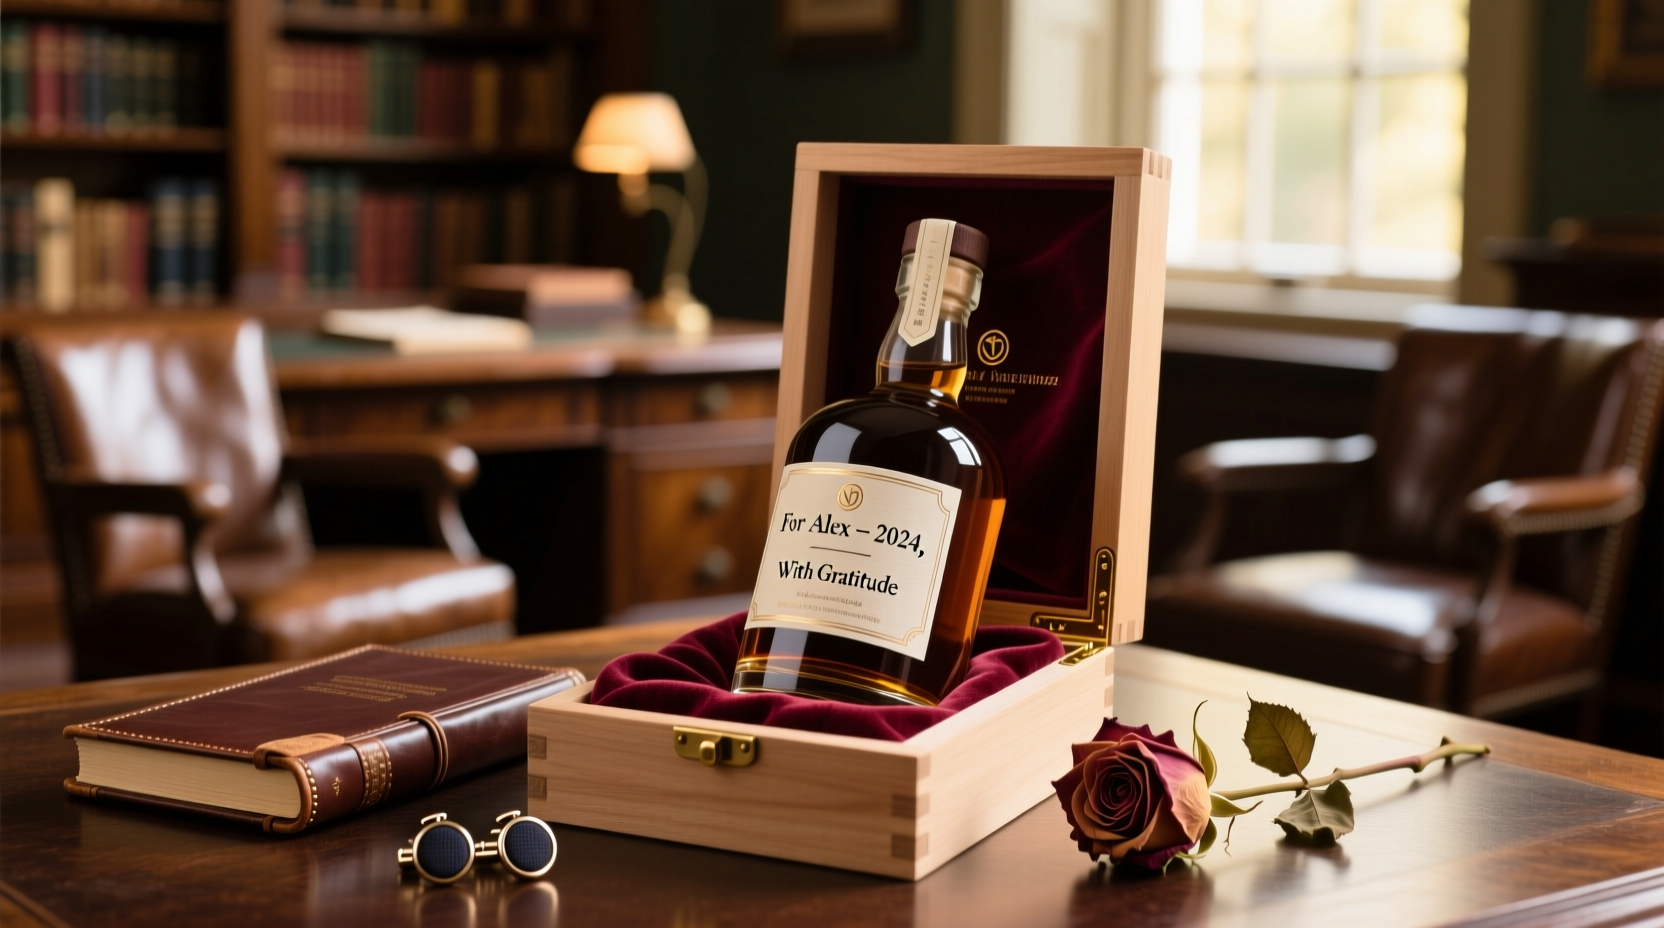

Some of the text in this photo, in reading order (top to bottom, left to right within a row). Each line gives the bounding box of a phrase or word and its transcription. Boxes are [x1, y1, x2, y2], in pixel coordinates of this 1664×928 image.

[780, 512, 806, 532] For
[809, 513, 851, 537] Alex
[874, 524, 925, 558] 2024,
[778, 560, 898, 595] With Gratitude
